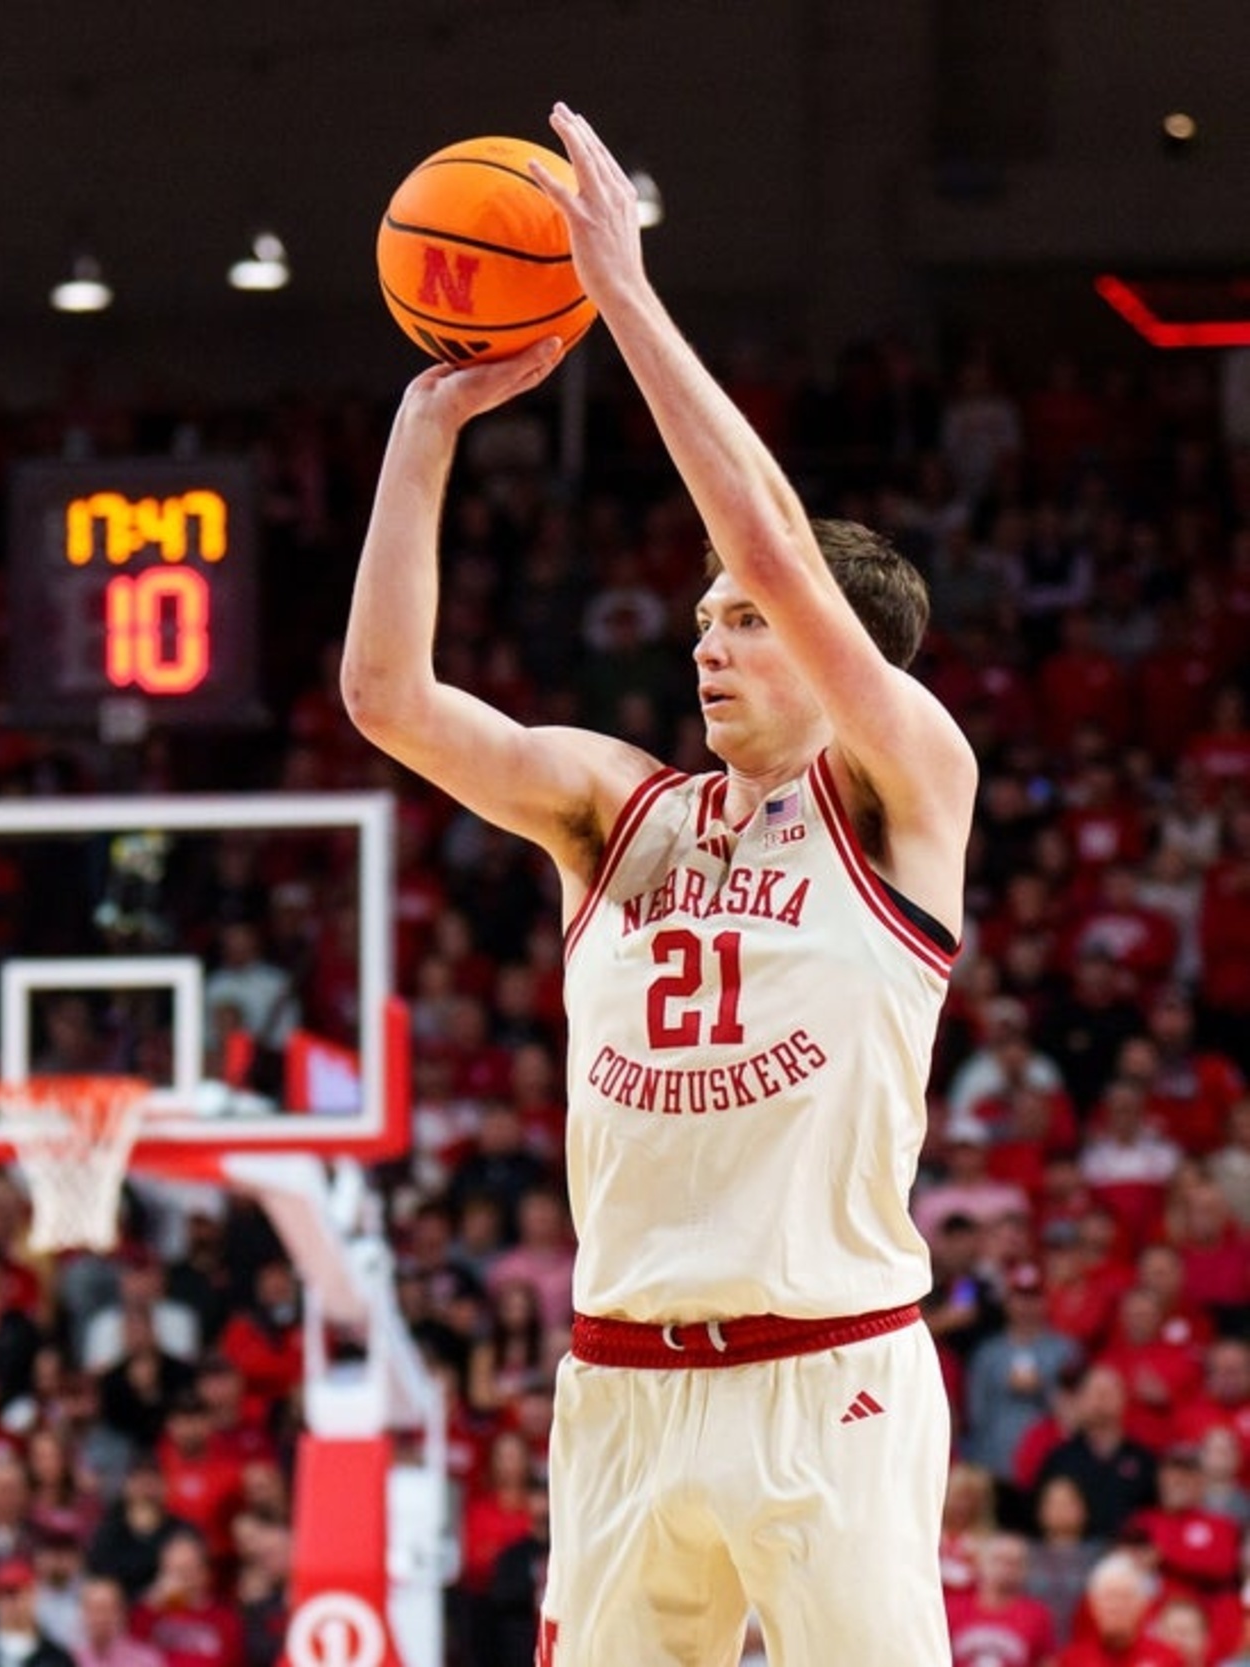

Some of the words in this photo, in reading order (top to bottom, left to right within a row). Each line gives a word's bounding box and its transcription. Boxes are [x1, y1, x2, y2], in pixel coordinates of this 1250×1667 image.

[417, 245, 479, 315] N
[105, 565, 210, 694] 10
[646, 929, 744, 1050] 21
[587, 1029, 827, 1114] CORNHUSKERS
